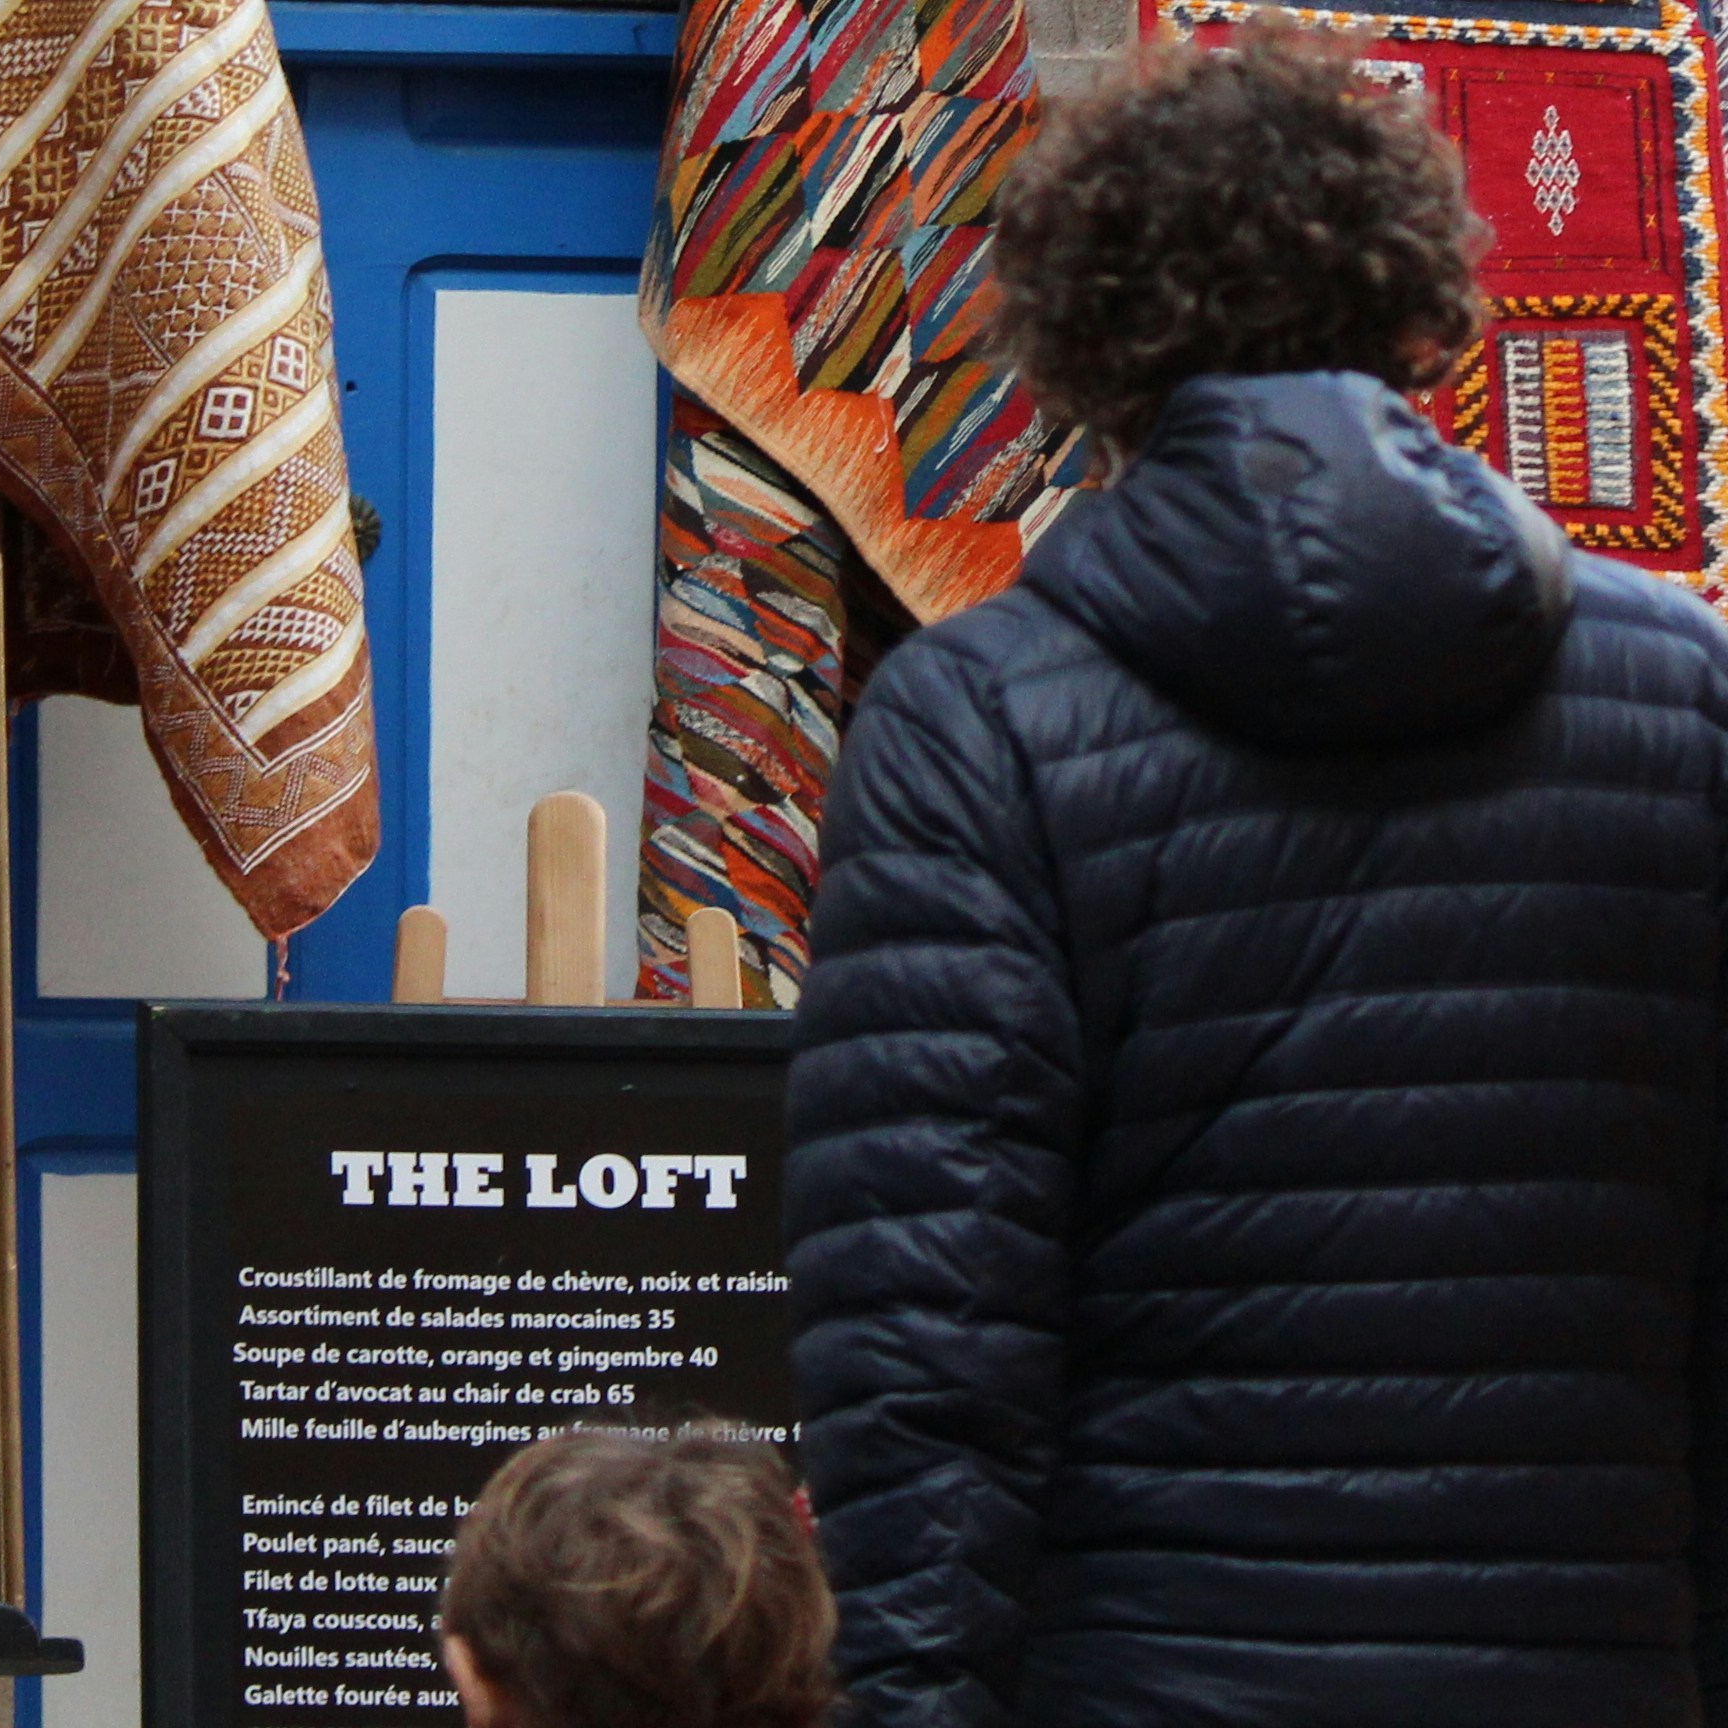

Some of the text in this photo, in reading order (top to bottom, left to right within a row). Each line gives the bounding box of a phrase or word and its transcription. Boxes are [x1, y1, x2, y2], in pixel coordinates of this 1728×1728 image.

[332, 1151, 746, 1208] THE LOFT
[239, 1267, 788, 1295] Croustillant de fromage de chèvre, noix et raisin
[239, 1305, 675, 1329] Assortiment de salades marocaines 35
[234, 1343, 718, 1371] Soupe de carotte, orange et gingembre 40
[240, 1381, 309, 1400] Tartar
[418, 1388, 446, 1402] au
[453, 1382, 510, 1403] chair
[516, 1383, 544, 1403] de
[551, 1383, 600, 1404] crab
[607, 1384, 635, 1404] 65
[243, 1494, 448, 1516] Emincé de filet de
